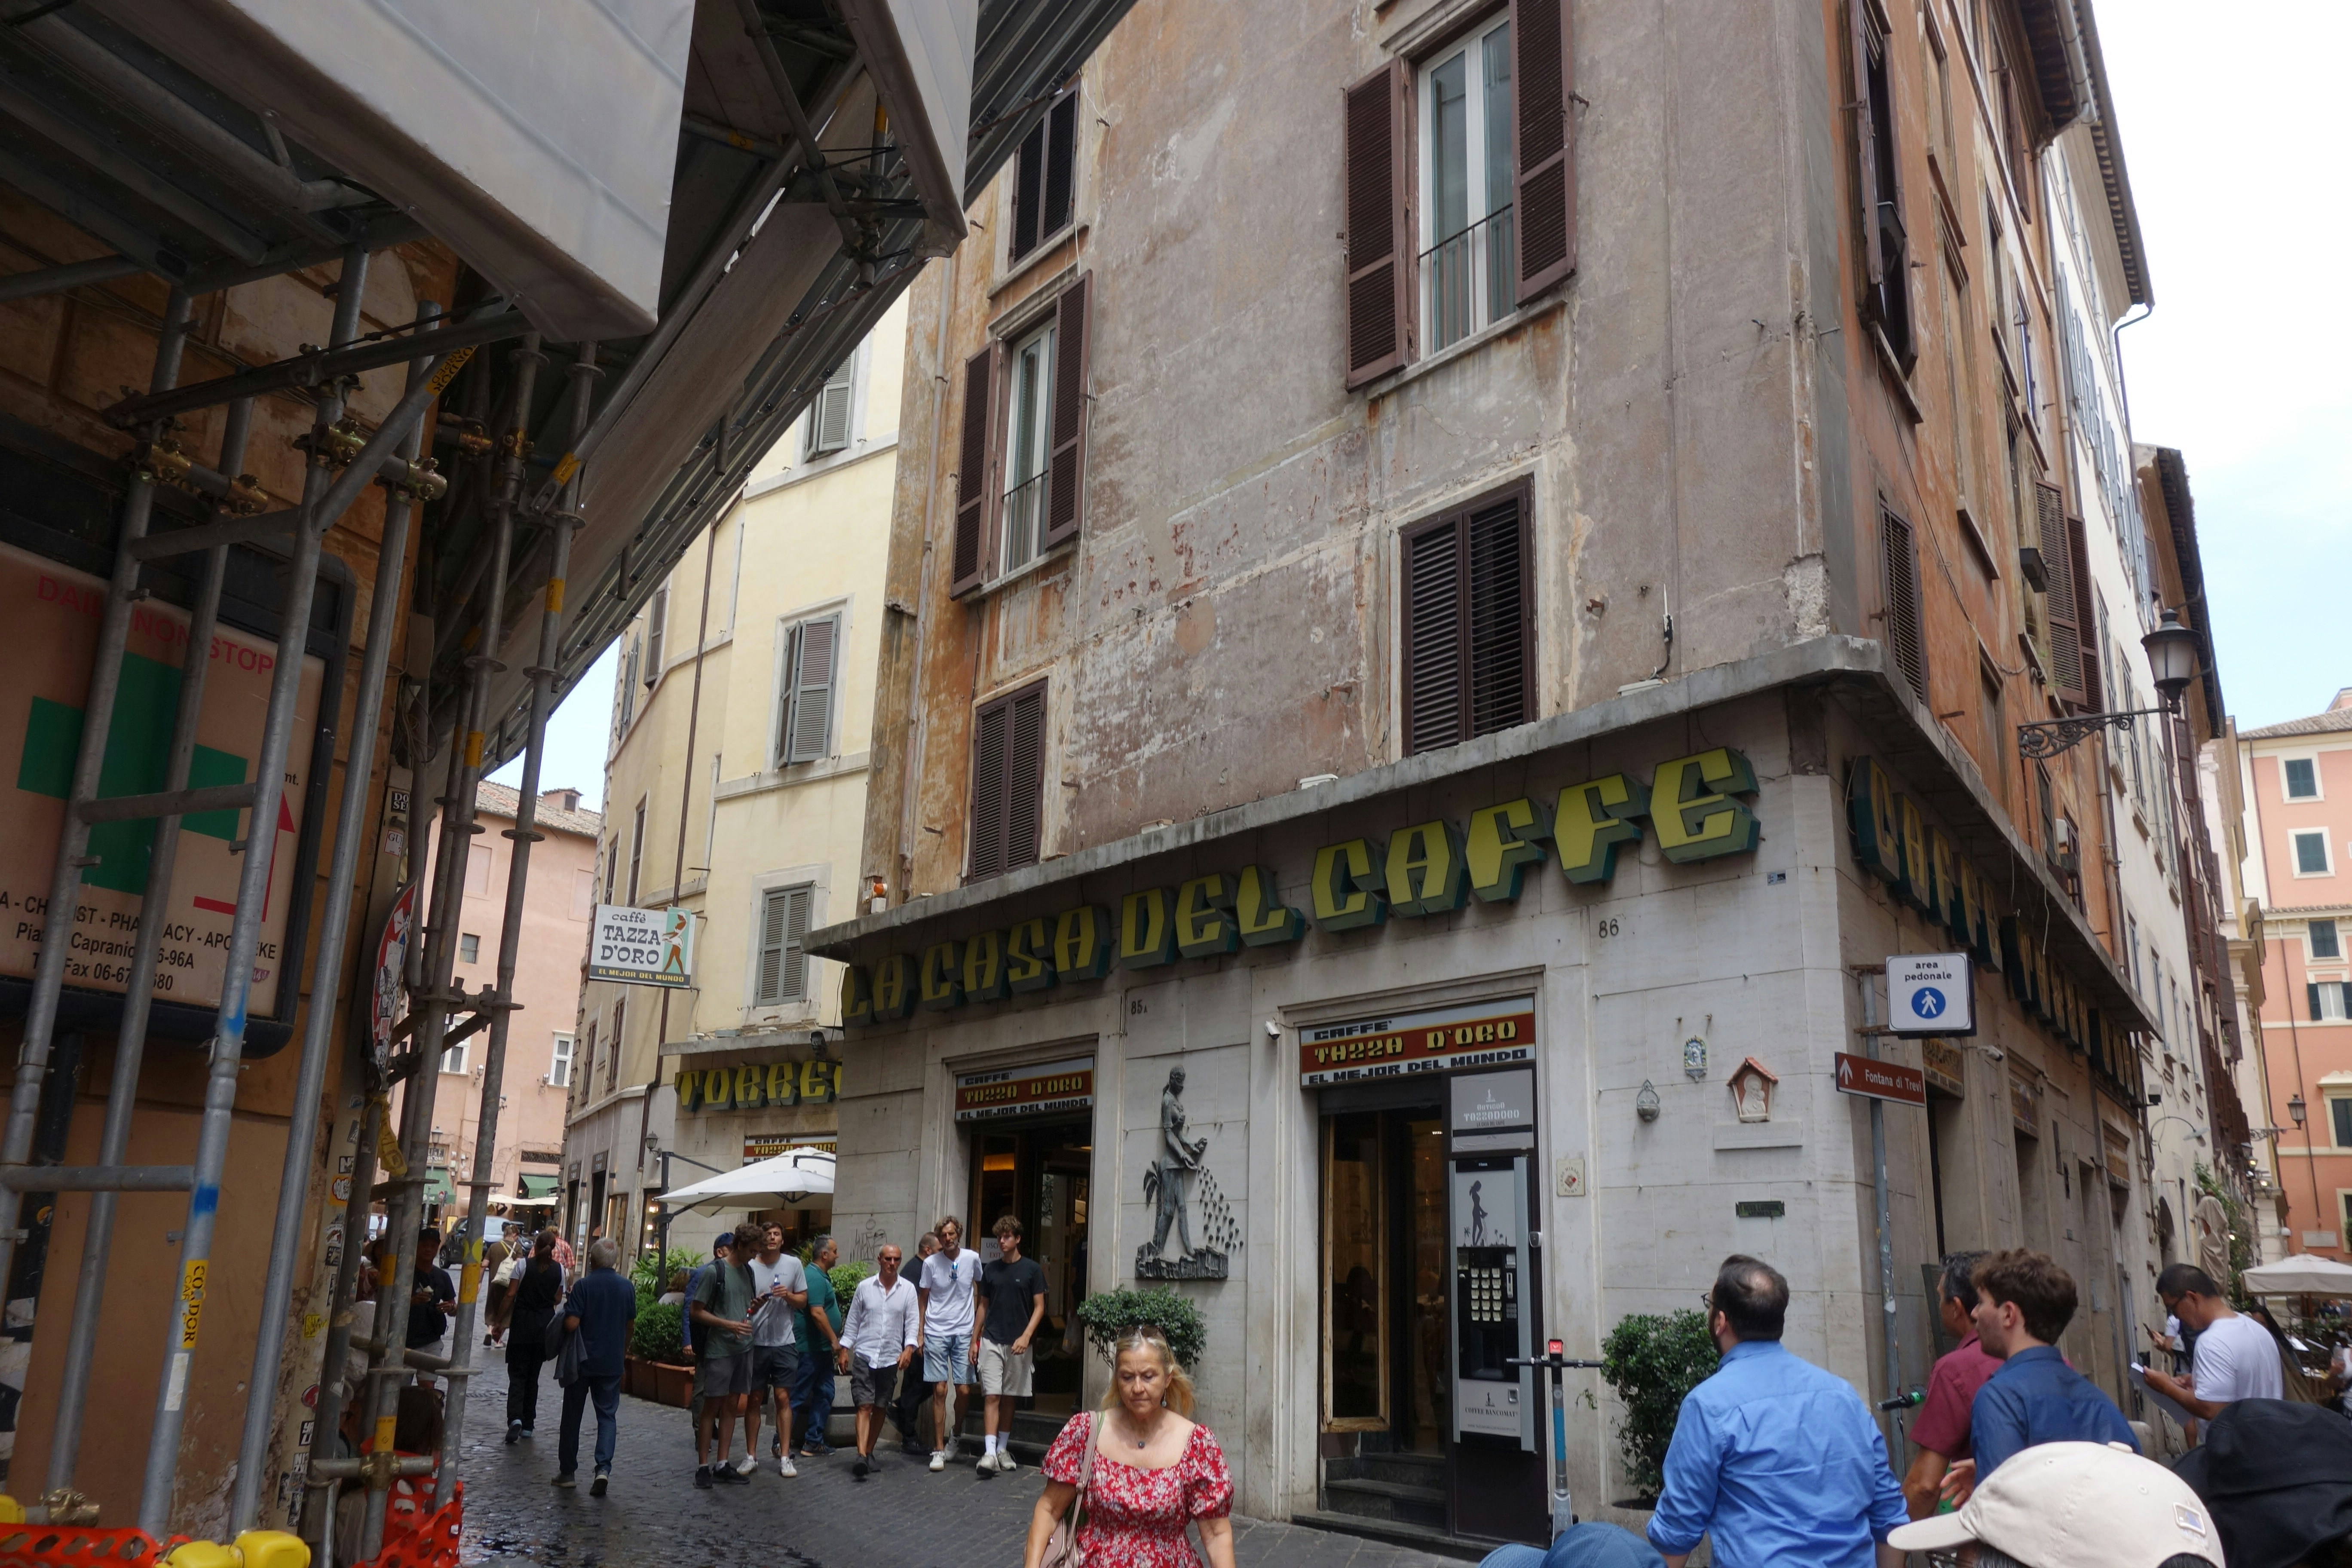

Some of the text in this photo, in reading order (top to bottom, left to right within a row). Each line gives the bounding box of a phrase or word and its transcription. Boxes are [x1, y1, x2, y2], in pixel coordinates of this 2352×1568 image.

[37, 575, 104, 619] DAIL
[841, 747, 1754, 1024] LA CASA DEL CAFFE
[612, 911, 646, 924] caffè
[1599, 918, 1619, 939] 86
[110, 912, 195, 943] PHAACY
[203, 931, 277, 959] APOKE
[603, 925, 661, 946] TAZZA
[70, 932, 134, 959] Capranic
[157, 947, 194, 969] 6-96A
[600, 944, 659, 965] D'ORO
[609, 969, 636, 978] MEJOR
[639, 971, 653, 980] DEL
[1905, 971, 1952, 983] pedonale
[1314, 1021, 1517, 1065] TAZZA D'ORO
[1309, 1048, 1527, 1085] EL MEJOR DEL MUNDO
[965, 1076, 1082, 1104] TAZZA D'ORO
[1865, 1069, 1922, 1093] Fontana di Trevi
[976, 1106, 1017, 1118] MEJOR
[1020, 1103, 1042, 1113] DEL
[1044, 1098, 1087, 1110] MUNDO
[1465, 1406, 1485, 1415] COFFEE
